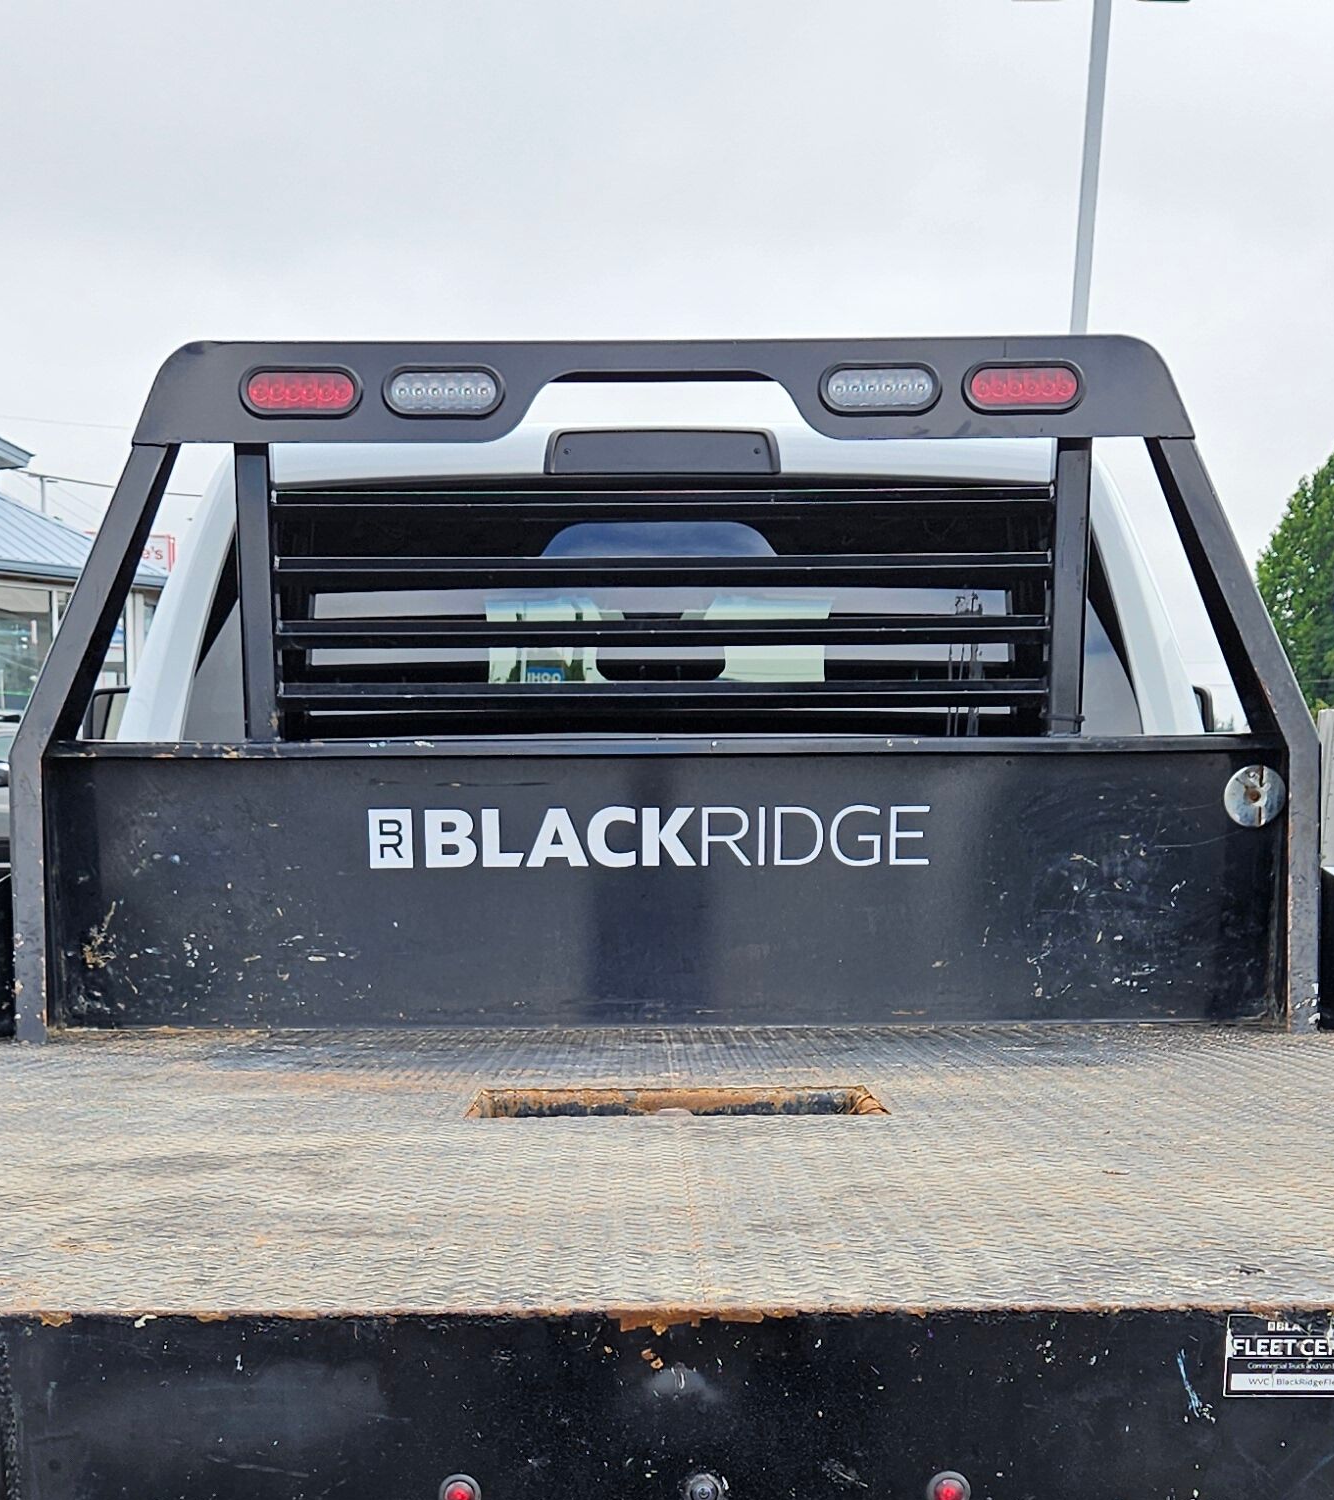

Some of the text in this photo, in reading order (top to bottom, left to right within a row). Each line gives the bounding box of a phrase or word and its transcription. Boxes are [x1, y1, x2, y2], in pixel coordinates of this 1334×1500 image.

[424, 804, 931, 868] BLACKRIDGE
[1233, 1338, 1297, 1356] FLEET
[1318, 1362, 1332, 1370] Van
